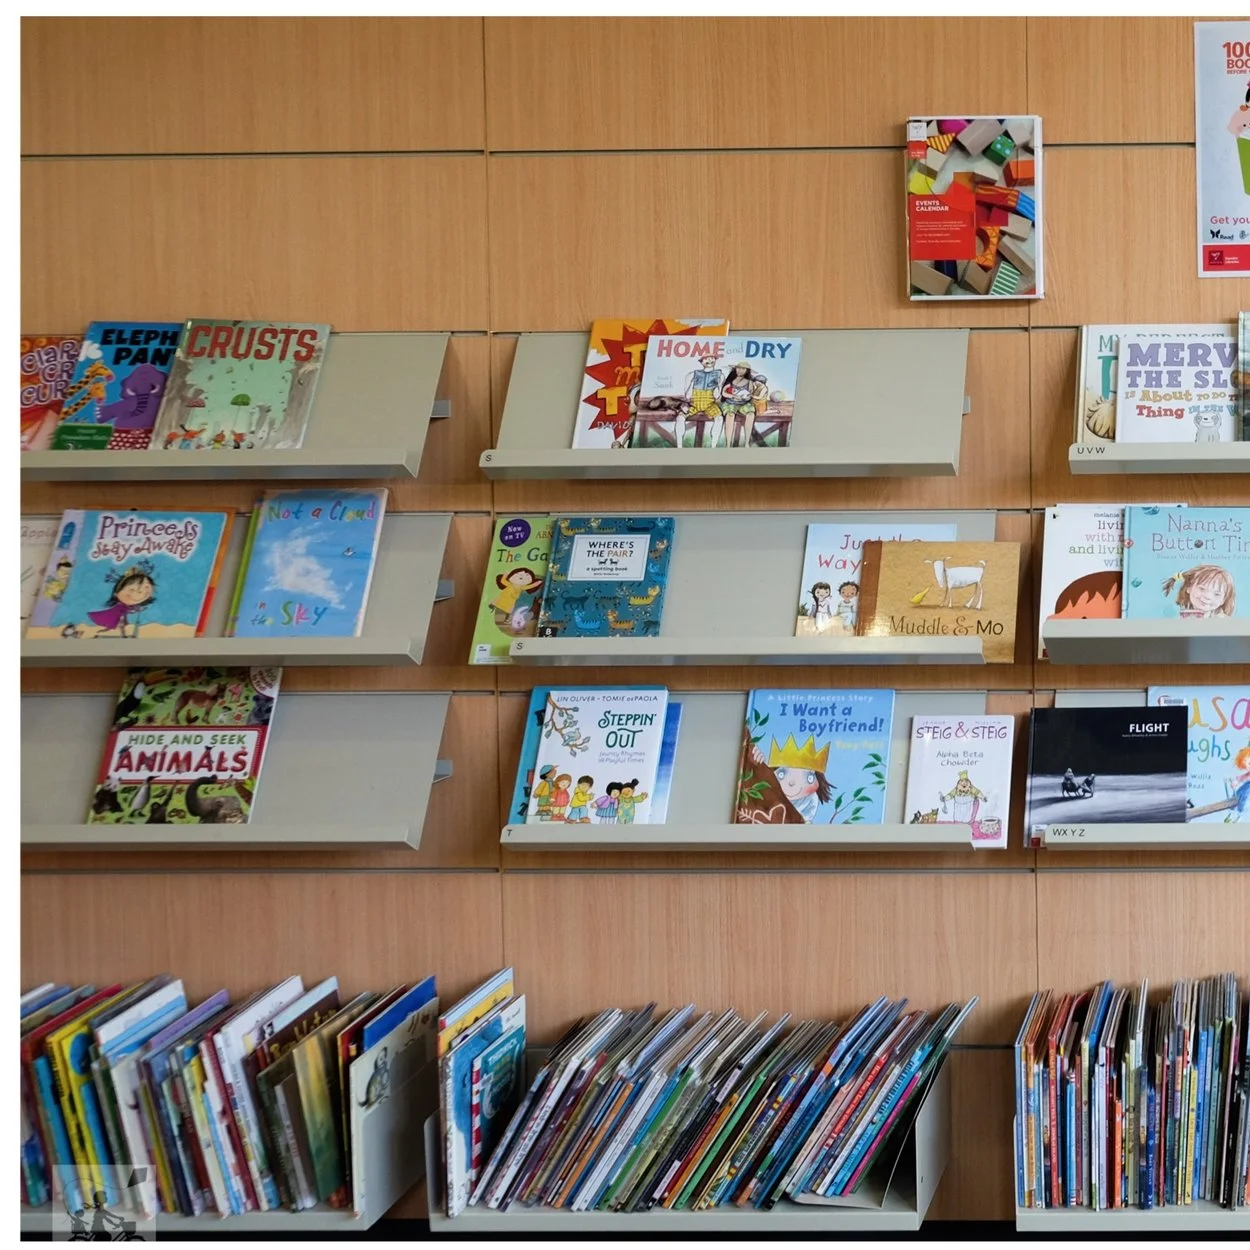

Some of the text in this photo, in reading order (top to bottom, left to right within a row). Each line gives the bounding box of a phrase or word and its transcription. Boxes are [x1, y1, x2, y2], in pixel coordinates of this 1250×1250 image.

[1210, 216, 1230, 224] Get
[188, 324, 318, 361] CRUSTS
[657, 339, 792, 358] HOME and DRY
[1127, 343, 1238, 367] MERV
[1126, 370, 1182, 388] THE
[1139, 389, 1226, 402] About TO DO
[1136, 405, 1184, 419] Thing
[267, 500, 376, 522] Not a Cloud
[97, 515, 199, 540] Princess
[1168, 513, 1243, 533] Nanna's
[588, 541, 634, 549] WHERE'S
[1085, 531, 1115, 542] with
[1152, 533, 1216, 552] Button
[91, 536, 195, 562] Stay Awake
[497, 549, 522, 563] The
[1068, 544, 1095, 554] and
[281, 600, 328, 626] Sky
[888, 615, 1004, 636] Muddle & Mo
[849, 694, 874, 702] Story
[780, 703, 853, 716] I Want a
[598, 710, 657, 729] STEPPIN'
[799, 717, 884, 737] Boyfriend!
[1129, 723, 1169, 733] FLIGHT
[128, 734, 248, 745] HIDE AND SEEK
[606, 728, 643, 748] OUT
[916, 721, 1007, 740] STEIG & STEIG
[114, 748, 248, 773] ANIMALS
